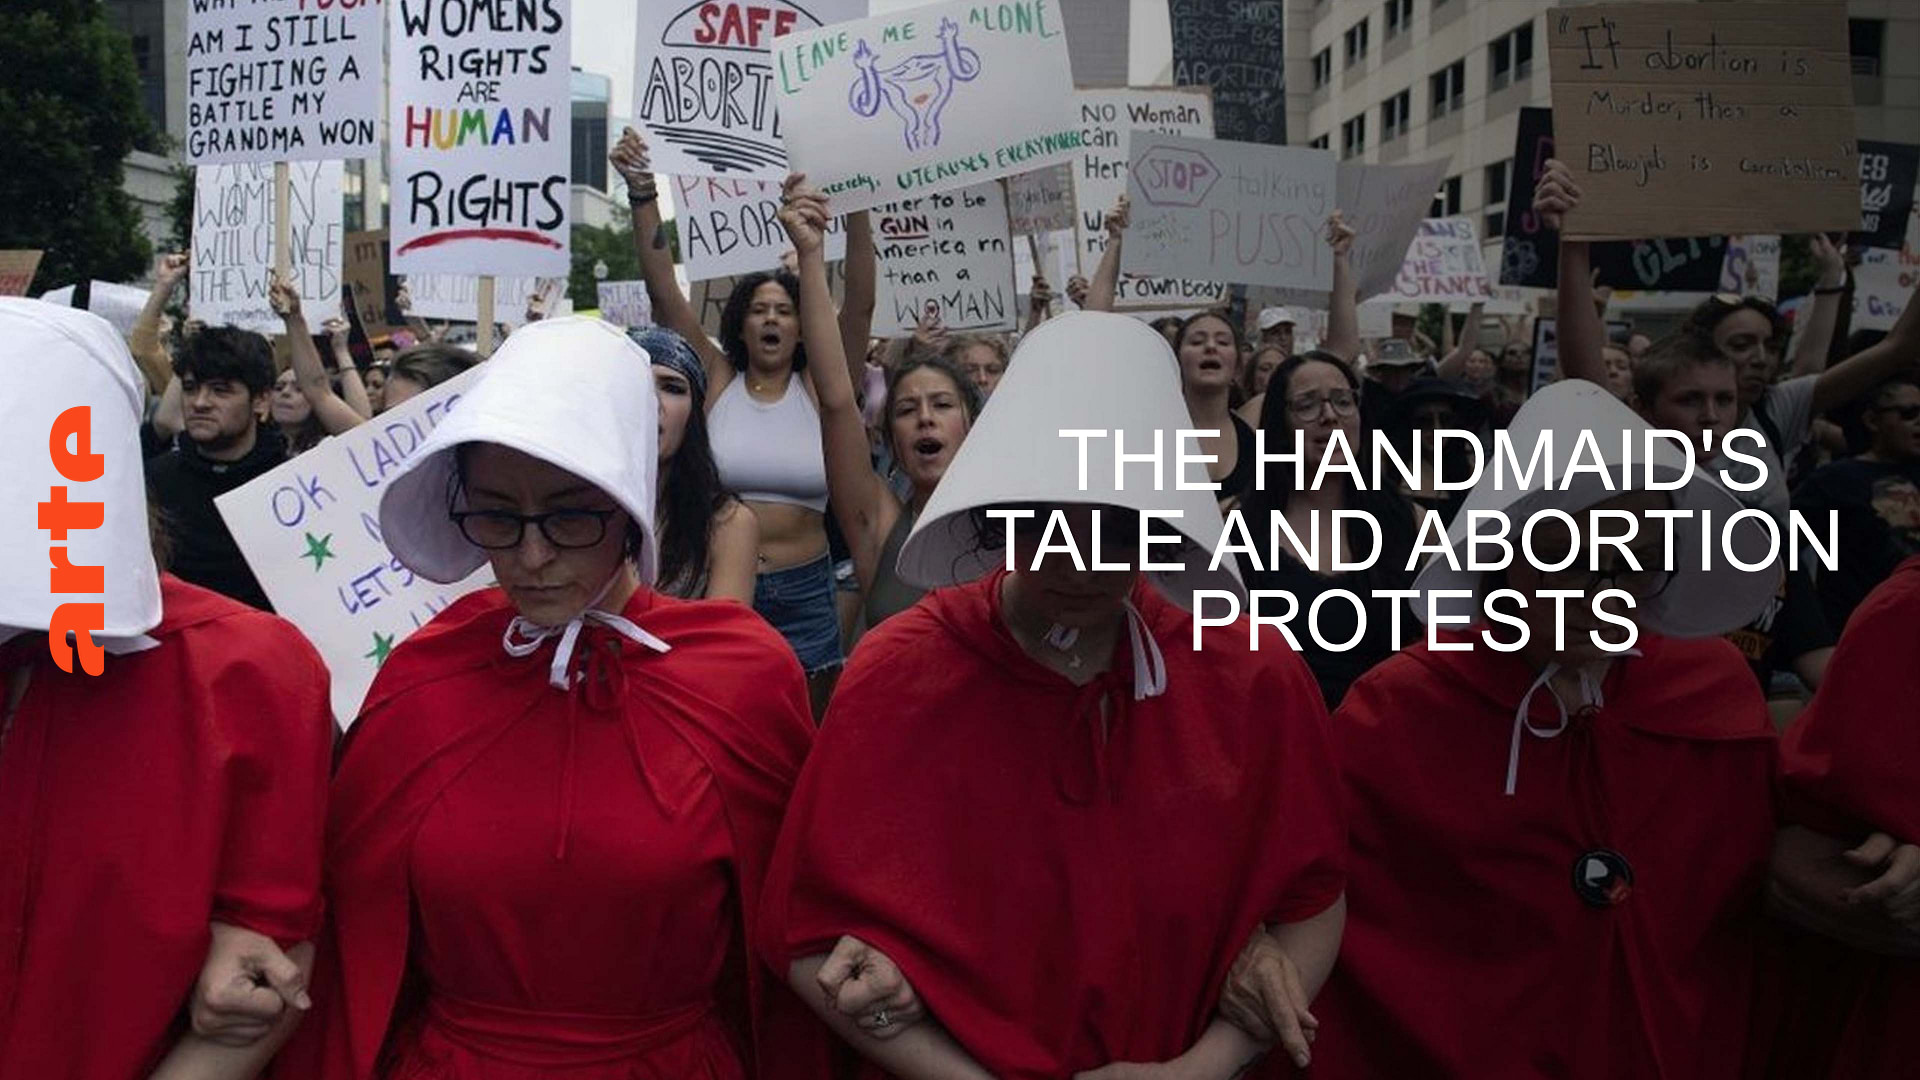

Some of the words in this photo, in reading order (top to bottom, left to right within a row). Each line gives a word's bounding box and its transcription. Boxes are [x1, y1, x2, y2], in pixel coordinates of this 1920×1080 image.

[188, 29, 223, 57] AM
[235, 25, 253, 51] I
[265, 15, 356, 51] STILL
[401, 0, 563, 37] WOMENS
[694, 3, 797, 47] SAFE
[419, 45, 551, 80] RIGHTS
[779, 32, 849, 95] LEAVE
[883, 22, 916, 44] ME
[1645, 28, 1759, 75] abortion
[1781, 50, 1809, 76] is
[190, 56, 327, 98] FIGHTING
[339, 55, 360, 82] A
[457, 81, 500, 102] ARE
[190, 97, 274, 127] BATTLE
[292, 91, 326, 115] MY
[405, 105, 551, 150] HUMAN
[1081, 103, 1116, 123] NO
[1127, 102, 1201, 124] Woman
[1779, 105, 1800, 120] a
[190, 126, 305, 158] GRANDMA
[320, 119, 374, 146] WON
[897, 153, 989, 191] UTERUSES
[1150, 158, 1209, 194] STOP
[1690, 153, 1710, 172] is
[407, 171, 567, 231] RIGHTS
[930, 193, 954, 210] to
[964, 190, 987, 208] be
[688, 200, 784, 259] ABOR
[880, 214, 929, 235] GUN
[937, 217, 954, 231] in
[1209, 208, 1327, 277] PUSSY
[194, 228, 246, 267] WILL
[253, 222, 341, 267] CHNGE
[978, 238, 1004, 253] rn
[194, 267, 236, 303] THE
[885, 267, 940, 286] than
[956, 268, 971, 281] a
[894, 283, 1005, 324] WOMAN
[272, 474, 337, 527] OK
